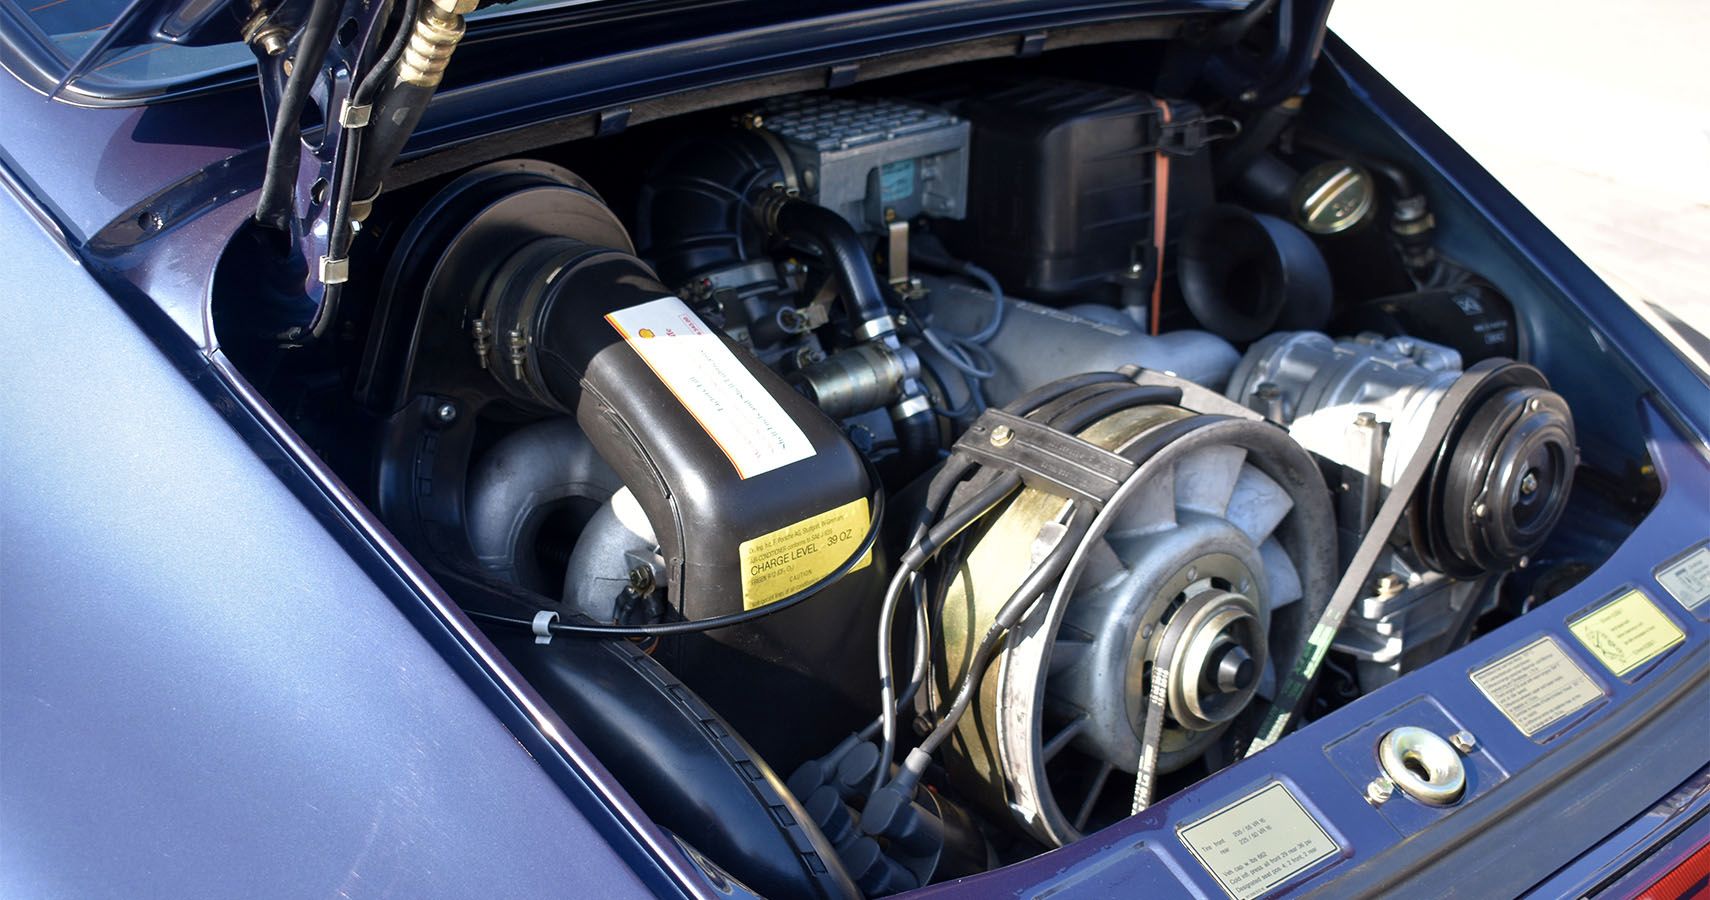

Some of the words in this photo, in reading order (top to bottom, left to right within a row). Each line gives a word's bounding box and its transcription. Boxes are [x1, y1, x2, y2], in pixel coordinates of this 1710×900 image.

[751, 553, 789, 575] CHARGE
[791, 544, 818, 560] LEVEL
[827, 535, 837, 546] 39
[839, 529, 852, 541] OZ
[789, 569, 812, 582] CAUTION
